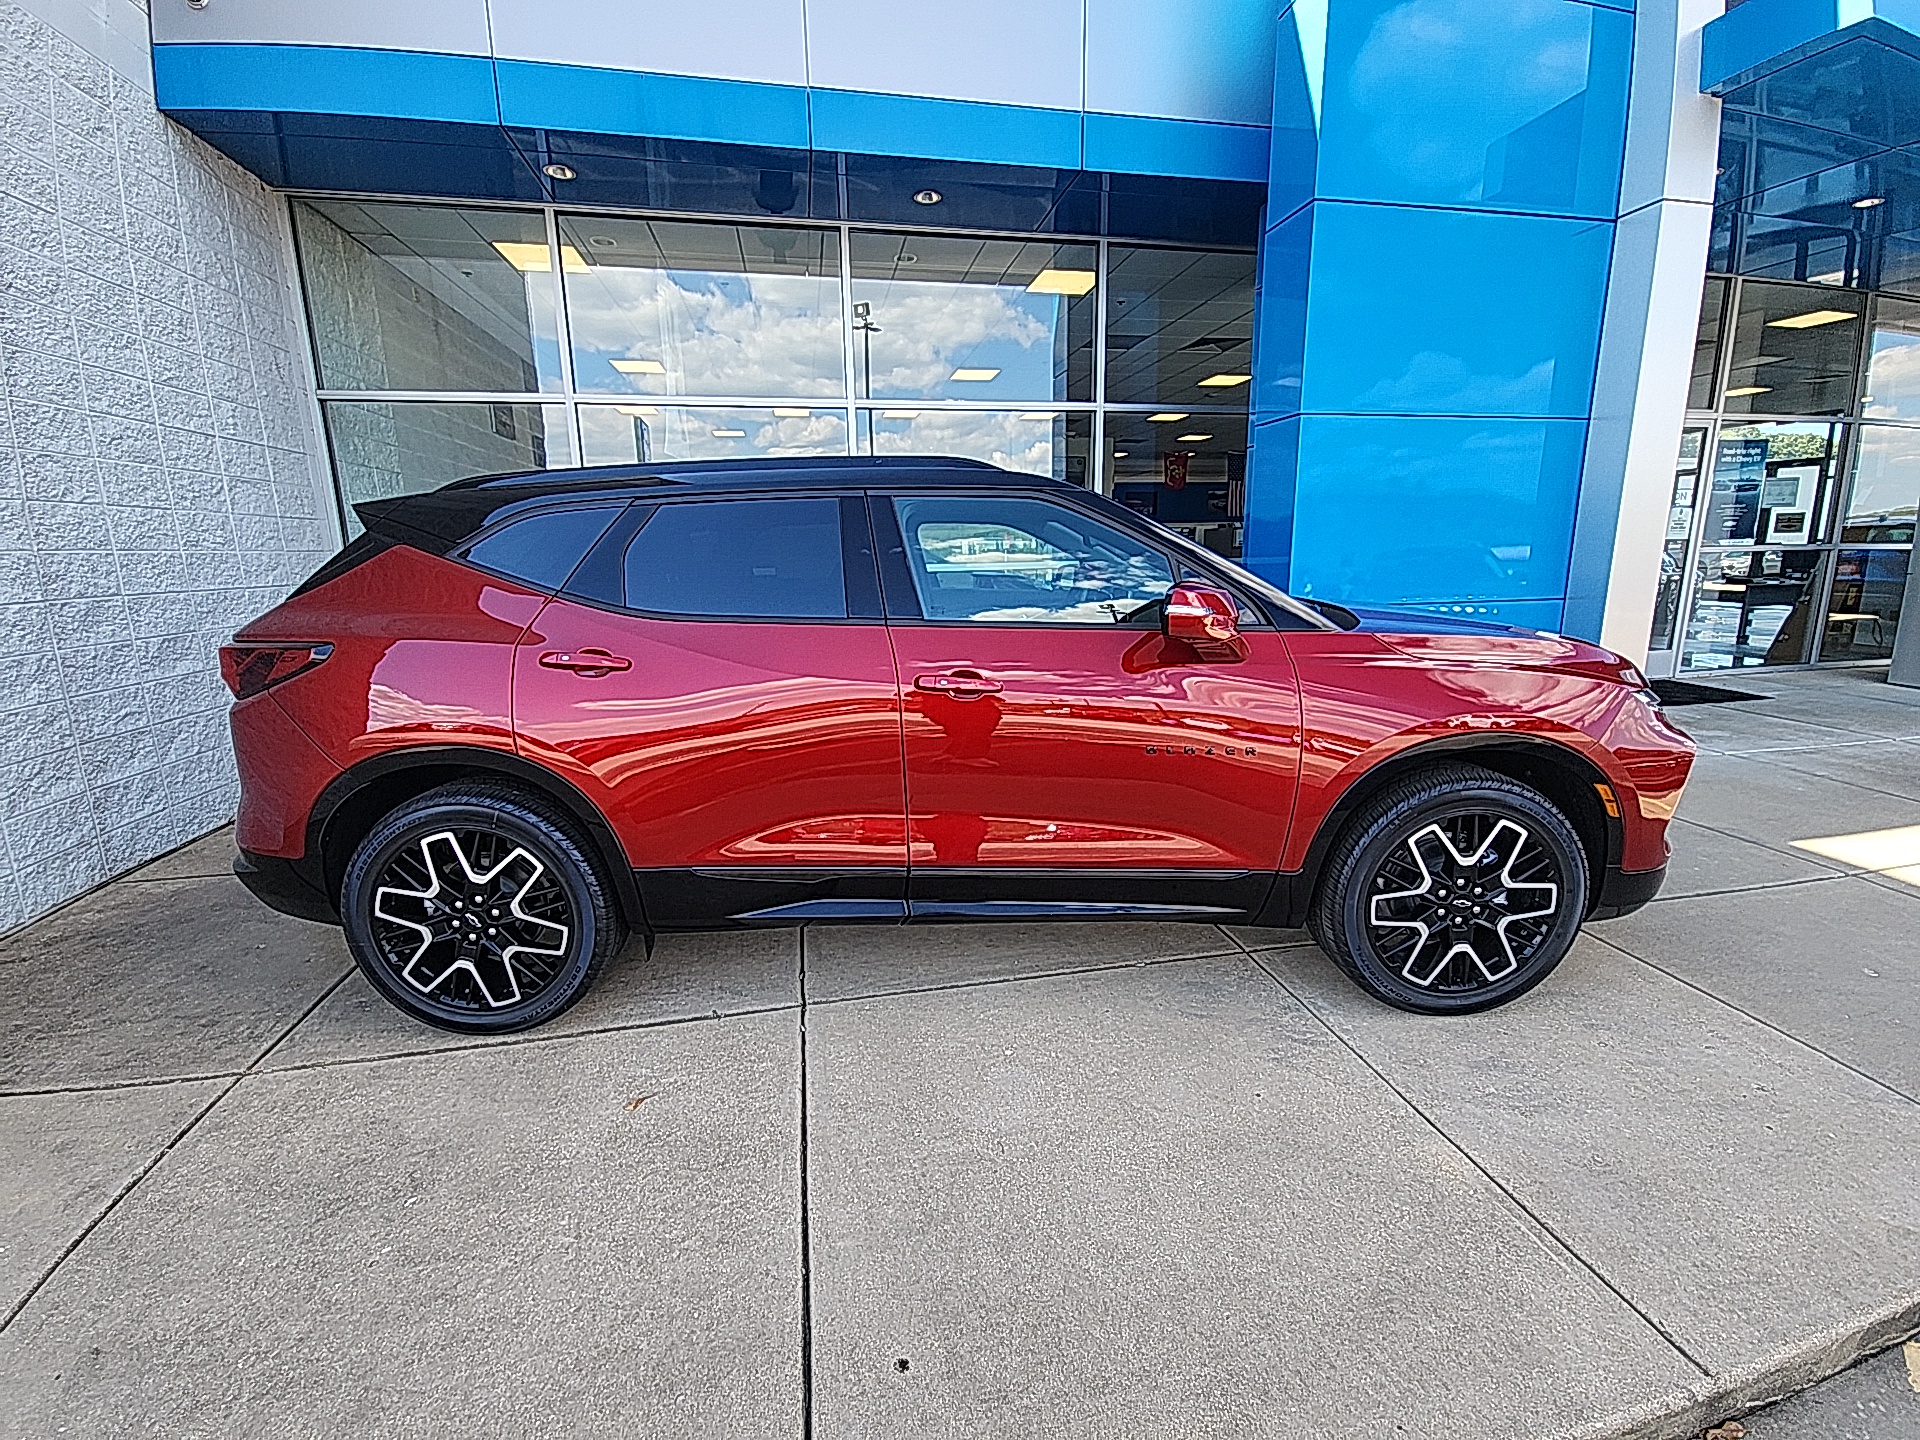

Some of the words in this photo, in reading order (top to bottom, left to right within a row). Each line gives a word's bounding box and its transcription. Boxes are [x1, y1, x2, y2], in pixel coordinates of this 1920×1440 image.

[1747, 448, 1761, 456] right
[1736, 455, 1753, 464] Chevy
[1145, 745, 1257, 757] BLAZER
[1355, 944, 1413, 1002] CONTINENTAL
[519, 964, 582, 1021] CONTINENTAL
